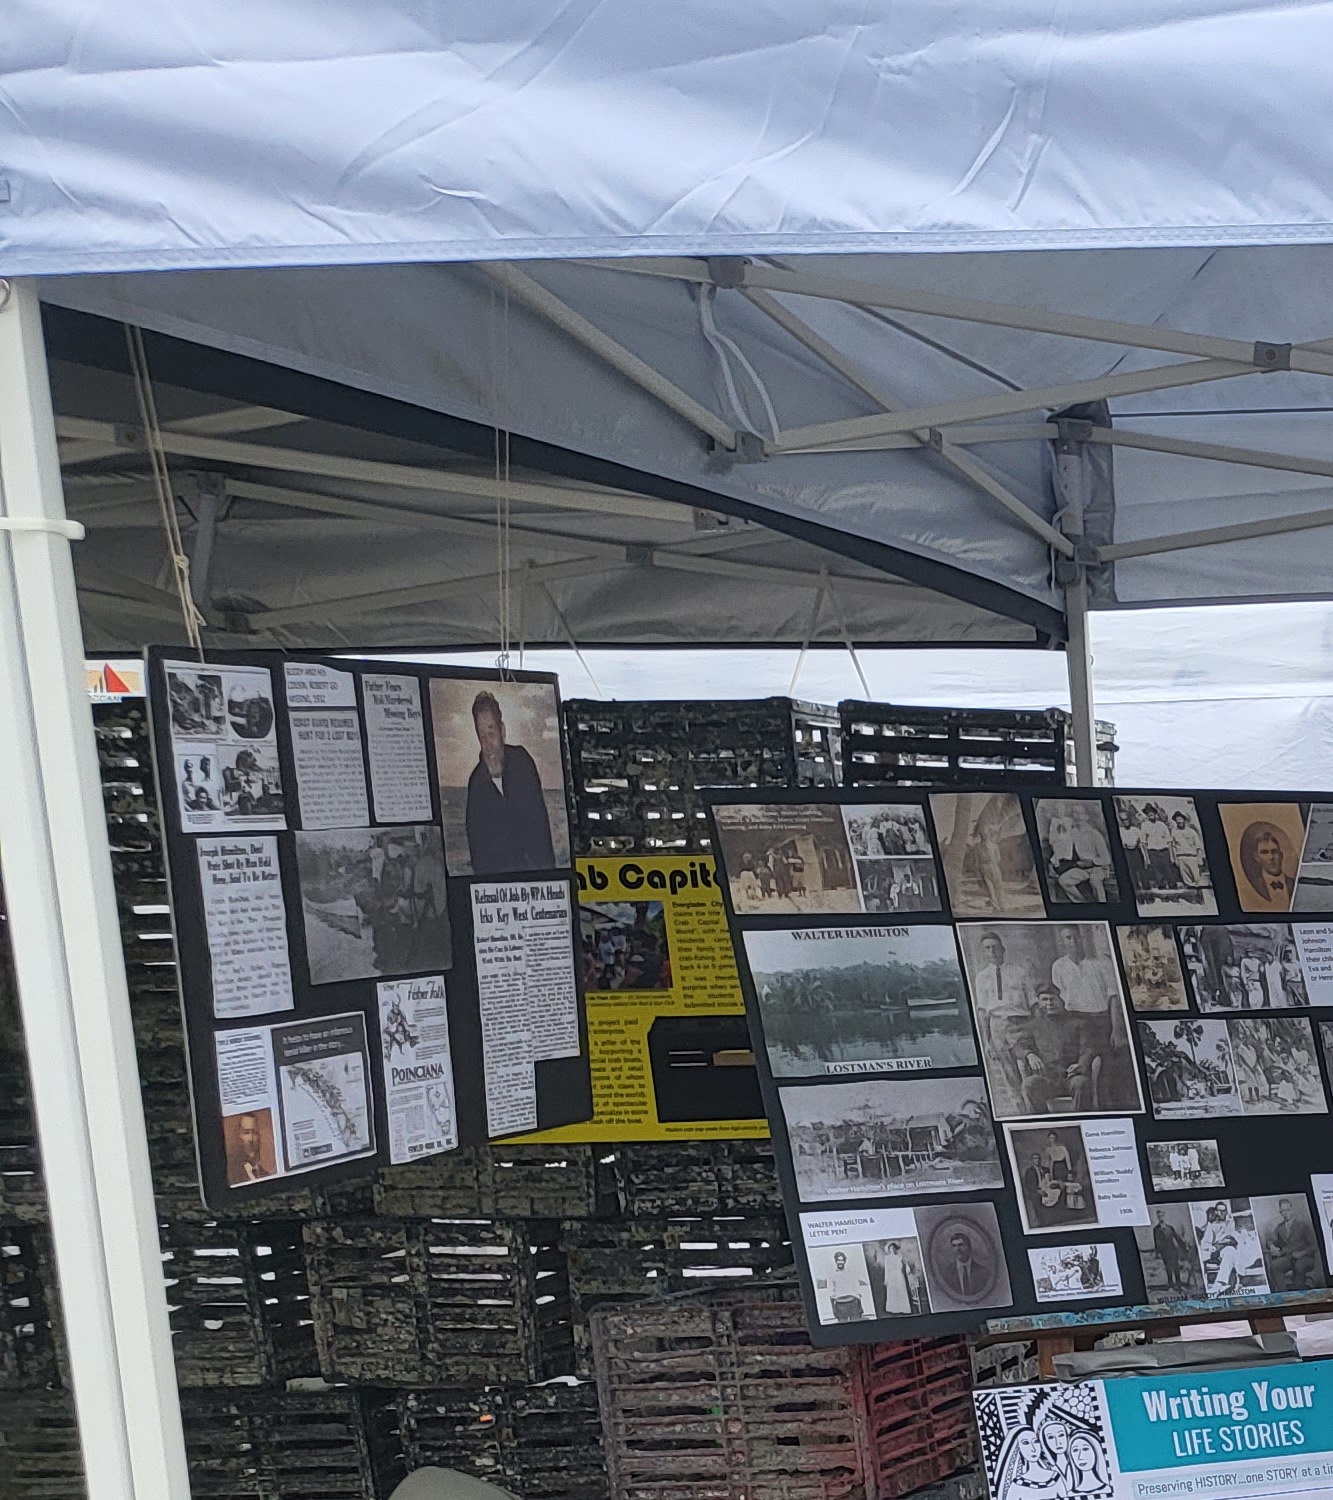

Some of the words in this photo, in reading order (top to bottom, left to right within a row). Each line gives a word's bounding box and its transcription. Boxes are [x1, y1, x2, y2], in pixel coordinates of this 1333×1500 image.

[792, 930, 844, 941] WALTER
[845, 928, 910, 938] HAMILTON
[826, 1060, 893, 1074] LOSTMAN'S
[896, 1059, 932, 1068] RIVER
[1142, 1387, 1249, 1422] Writing
[1252, 1382, 1315, 1411] Your
[1172, 1428, 1216, 1458] LIFE
[1218, 1420, 1305, 1453] STORIES
[1138, 1479, 1193, 1495] Preserving
[1266, 1467, 1298, 1481] STORY
[1302, 1466, 1312, 1477] at
[1315, 1467, 1320, 1476] a
